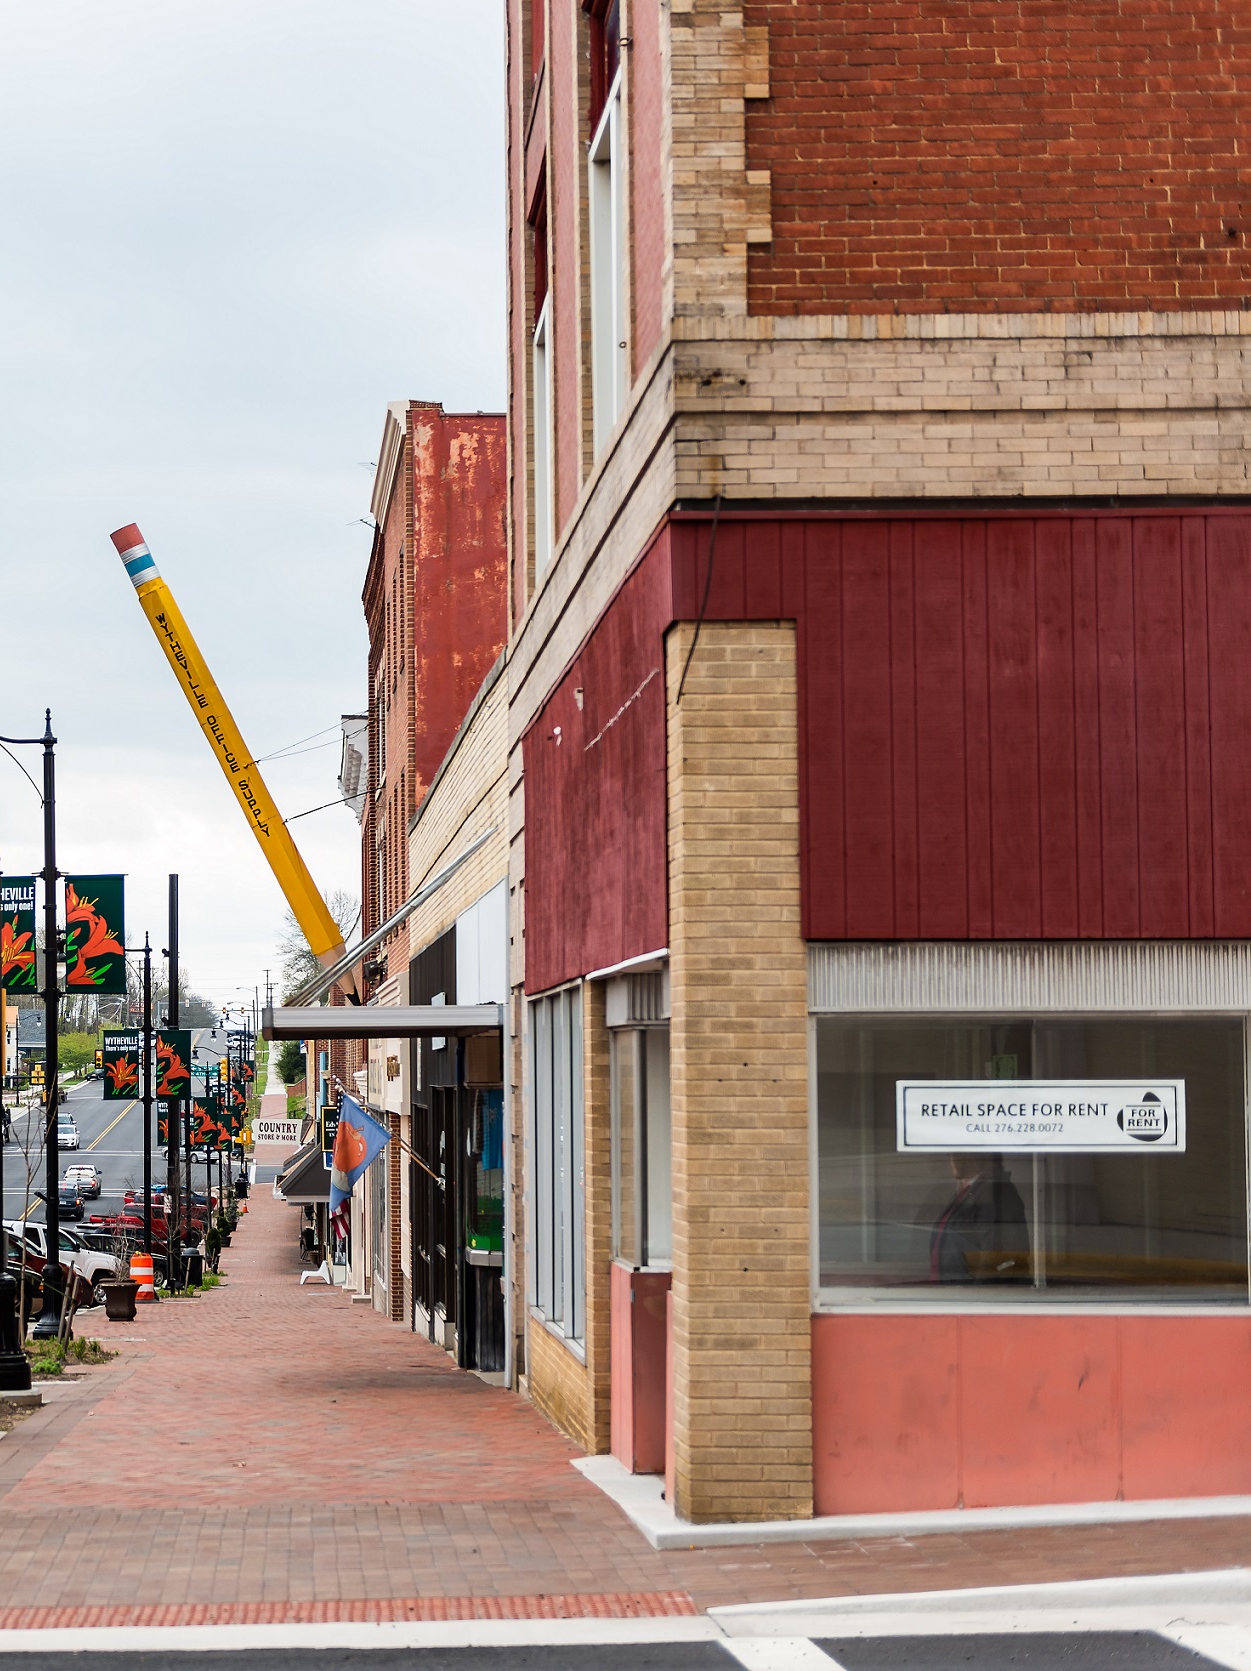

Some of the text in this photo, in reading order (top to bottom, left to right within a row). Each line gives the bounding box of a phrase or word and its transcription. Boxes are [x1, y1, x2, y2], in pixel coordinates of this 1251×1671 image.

[155, 612, 271, 837] WYTHEVILLE OFFICE SUPPLY
[3, 901, 18, 913] only
[105, 1036, 138, 1045] WYTHEVILLE
[920, 1103, 1109, 1117] RETAIL SPACE FOR RENT
[1131, 1108, 1156, 1118] FOR
[259, 1122, 298, 1133] COUNTRY
[966, 1123, 1064, 1133] CALL 276.228.0072
[1127, 1118, 1161, 1128] RENT
[258, 1133, 274, 1141] STORE
